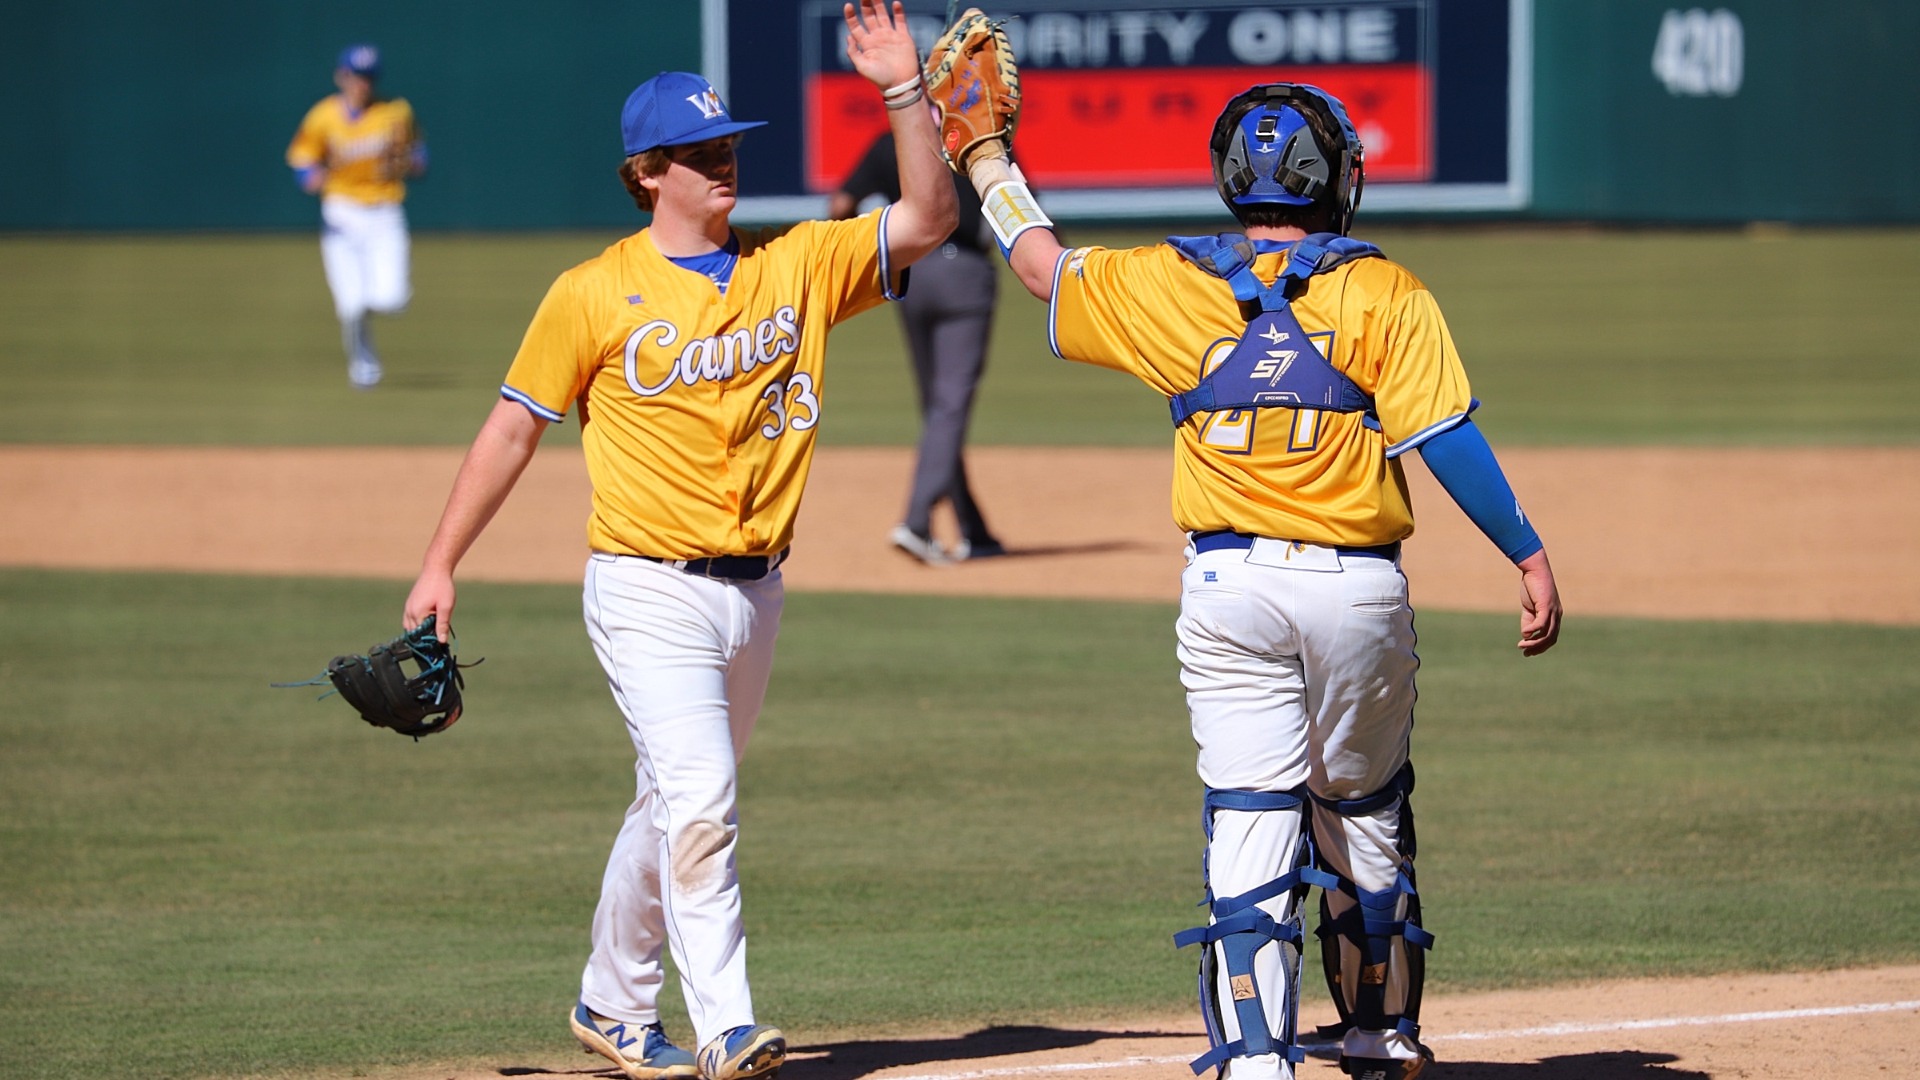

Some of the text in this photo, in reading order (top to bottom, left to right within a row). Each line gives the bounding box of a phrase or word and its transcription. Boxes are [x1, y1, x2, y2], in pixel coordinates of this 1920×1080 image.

[1227, 8, 1399, 65] ONE
[1652, 8, 1744, 96] 420
[624, 305, 801, 397] Canes
[761, 371, 820, 439] 33
